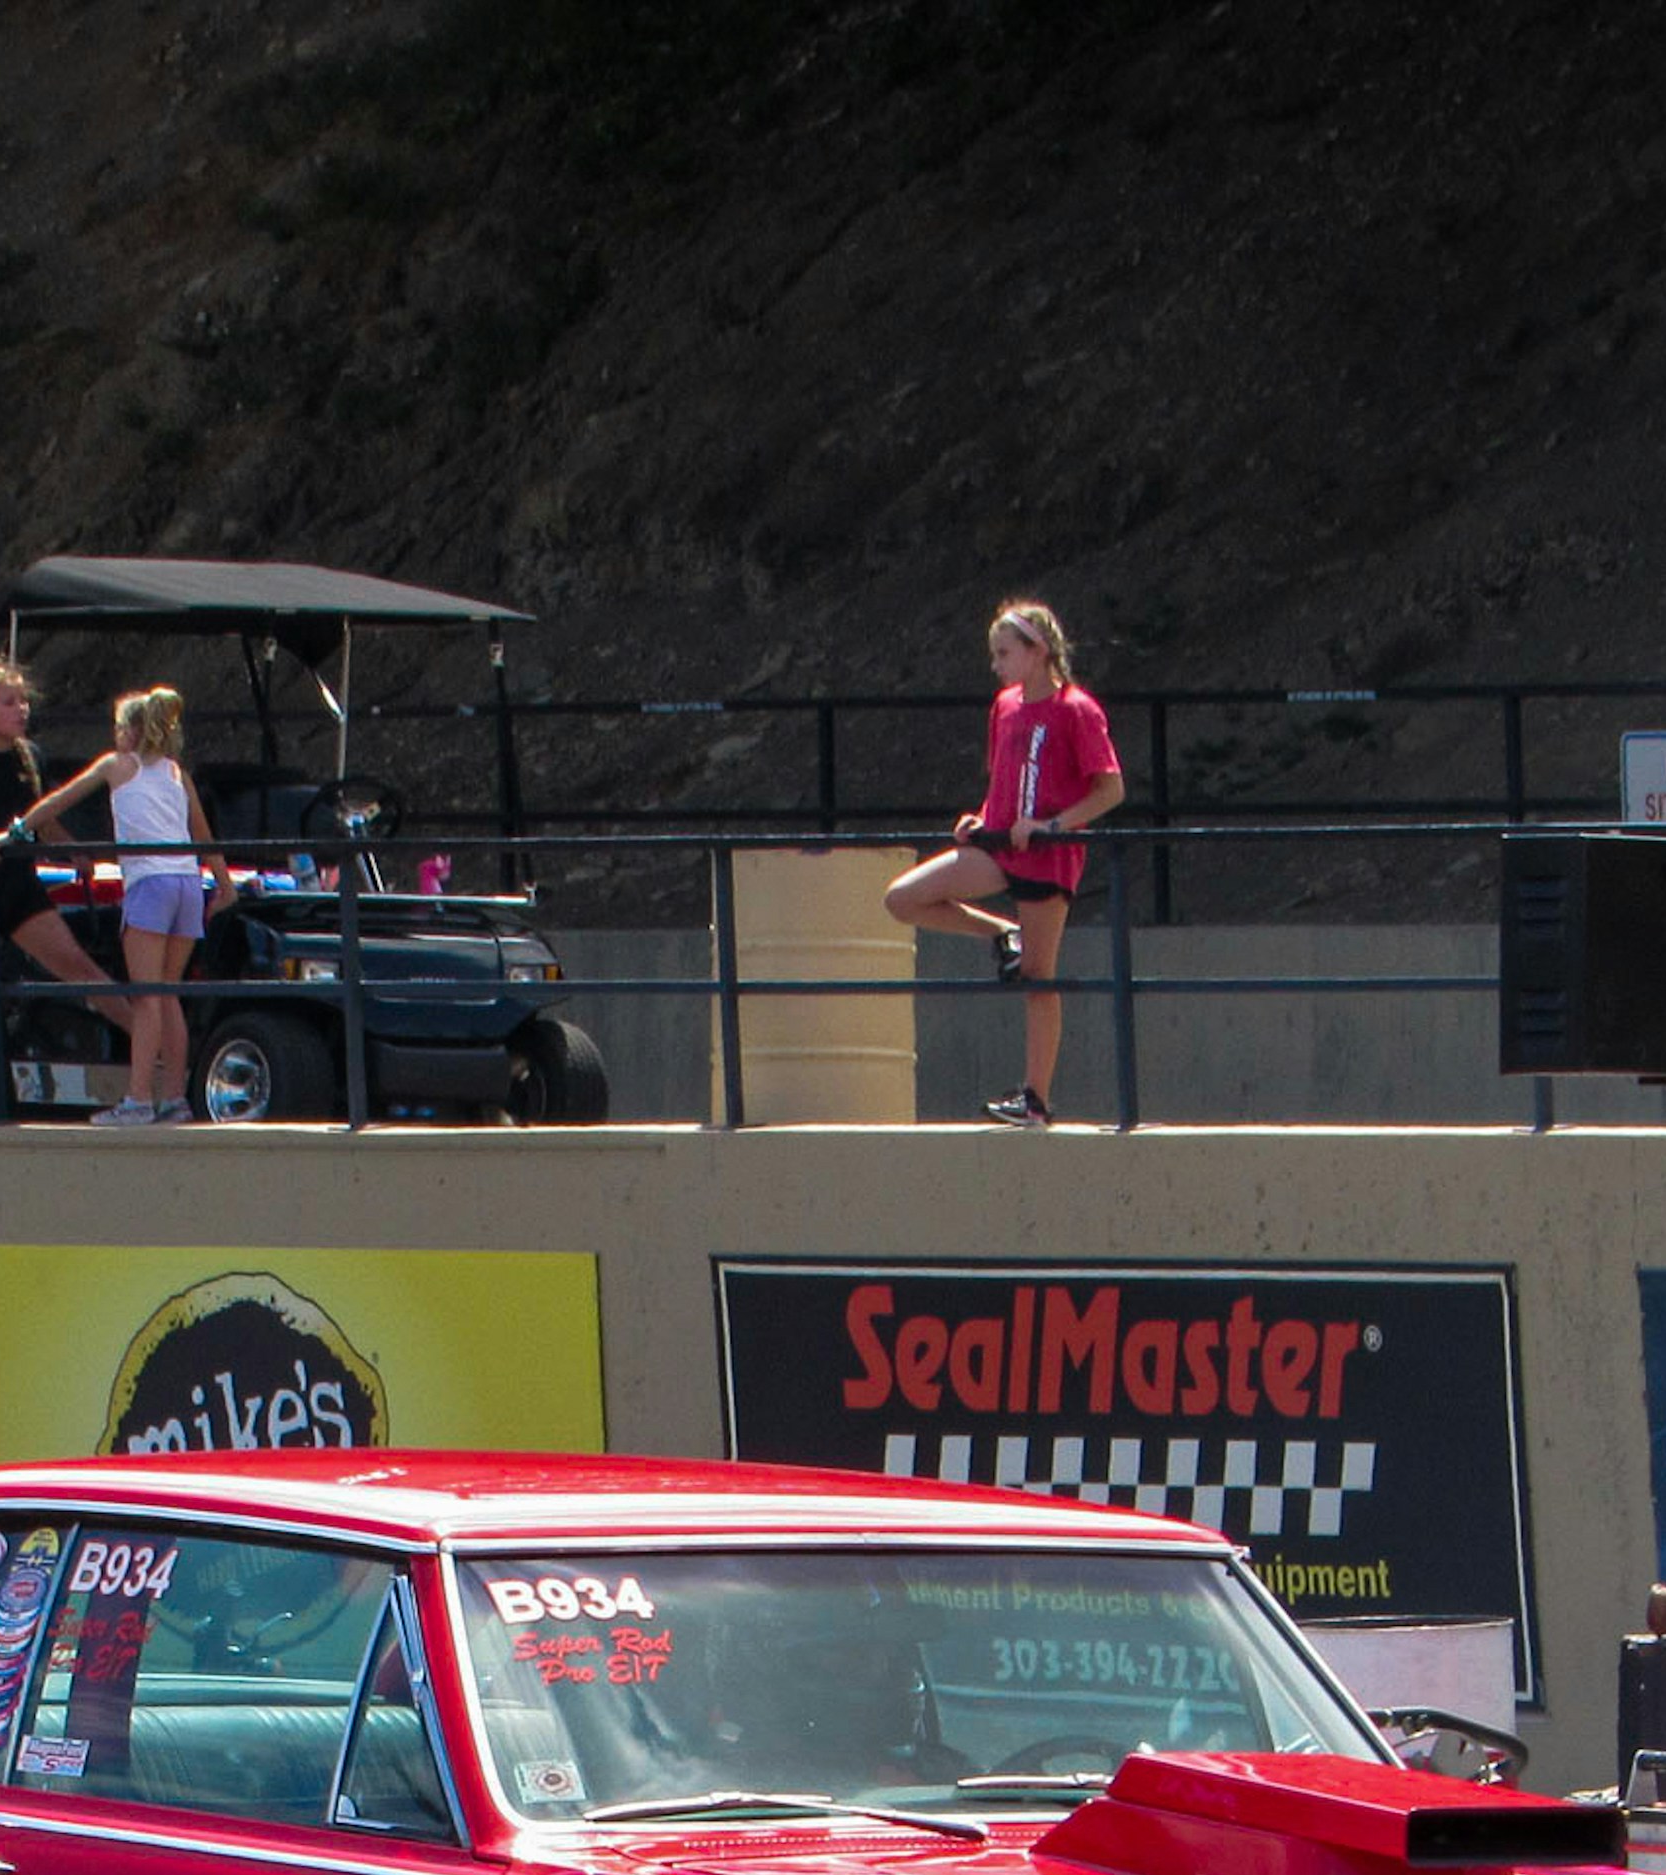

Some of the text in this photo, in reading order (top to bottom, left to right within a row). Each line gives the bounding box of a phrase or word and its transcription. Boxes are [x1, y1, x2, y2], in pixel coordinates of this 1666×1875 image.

[69, 1540, 180, 1599] B934
[1257, 1555, 1392, 1606] uipment
[484, 1574, 656, 1625] B934
[512, 1626, 674, 1662] Super Rod
[535, 1657, 598, 1687] Pro
